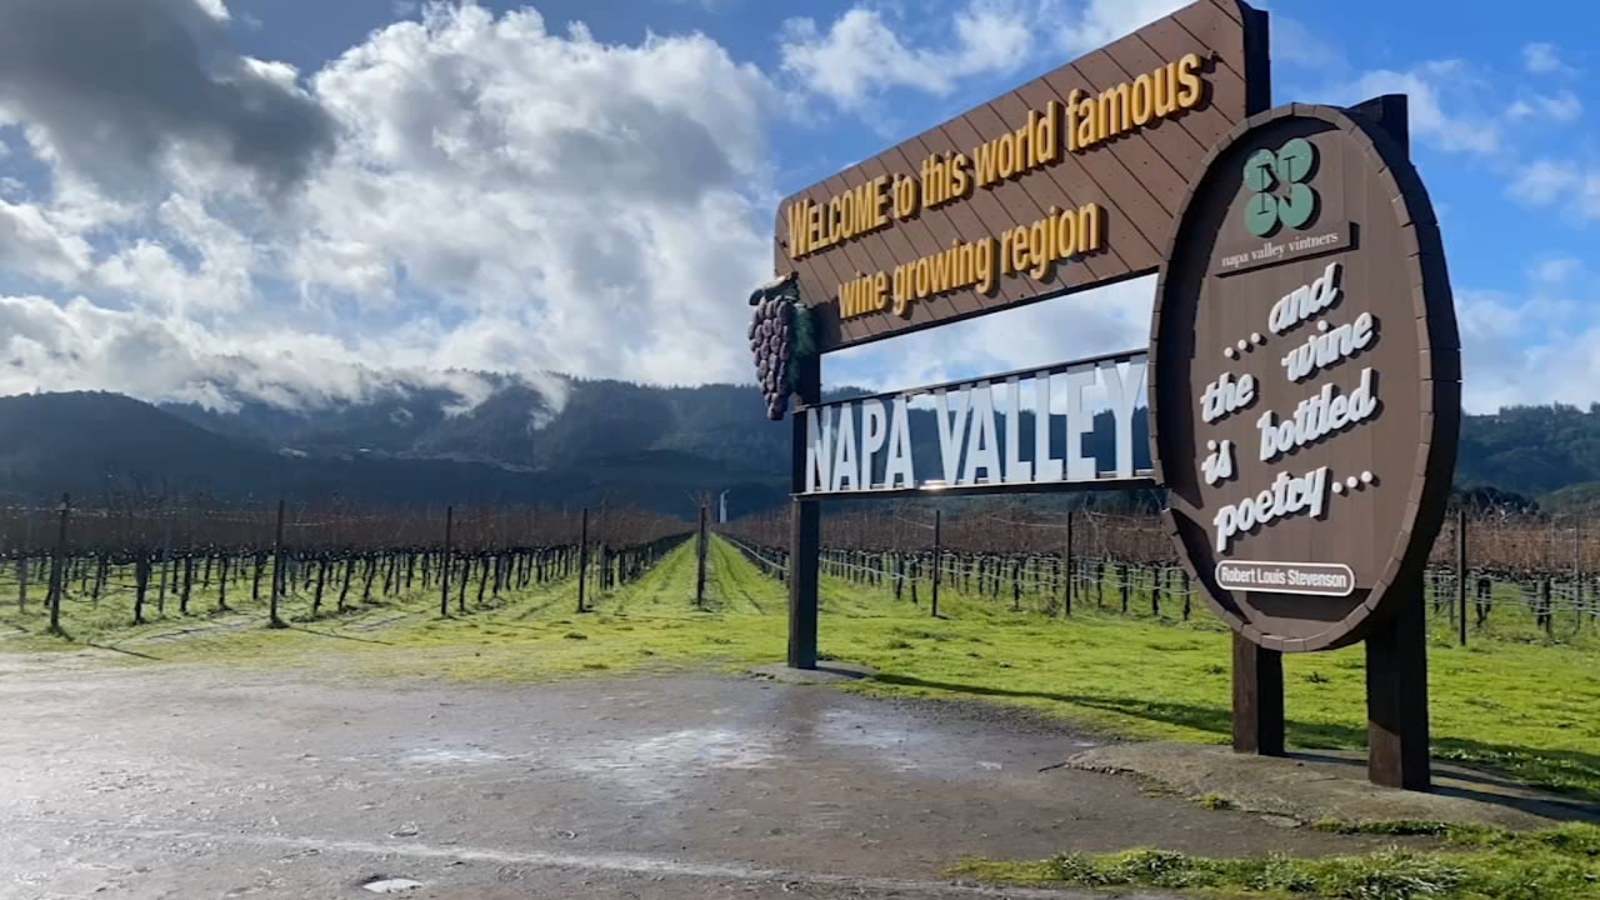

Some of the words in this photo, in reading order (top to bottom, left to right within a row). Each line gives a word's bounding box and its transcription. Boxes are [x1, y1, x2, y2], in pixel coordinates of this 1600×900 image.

[788, 176, 889, 260] WELCOME
[893, 172, 917, 217] to
[920, 149, 969, 207] this
[973, 100, 1058, 187] world
[1065, 52, 1202, 151] famous
[838, 268, 888, 319] wine
[892, 235, 994, 315] growing
[1001, 202, 1100, 280] region
[1221, 252, 1249, 268] napa
[1251, 242, 1286, 259] valley
[1288, 232, 1339, 252] vintners
[805, 393, 915, 493] NAPA
[933, 354, 1148, 485] VALLEY
[1200, 372, 1254, 422] the
[1281, 312, 1373, 381] wine
[1201, 440, 1232, 484] is
[1257, 367, 1377, 460] bottled
[1221, 567, 1256, 583] Robert
[1257, 569, 1286, 584] Louis
[1286, 571, 1347, 588] Stevenson
